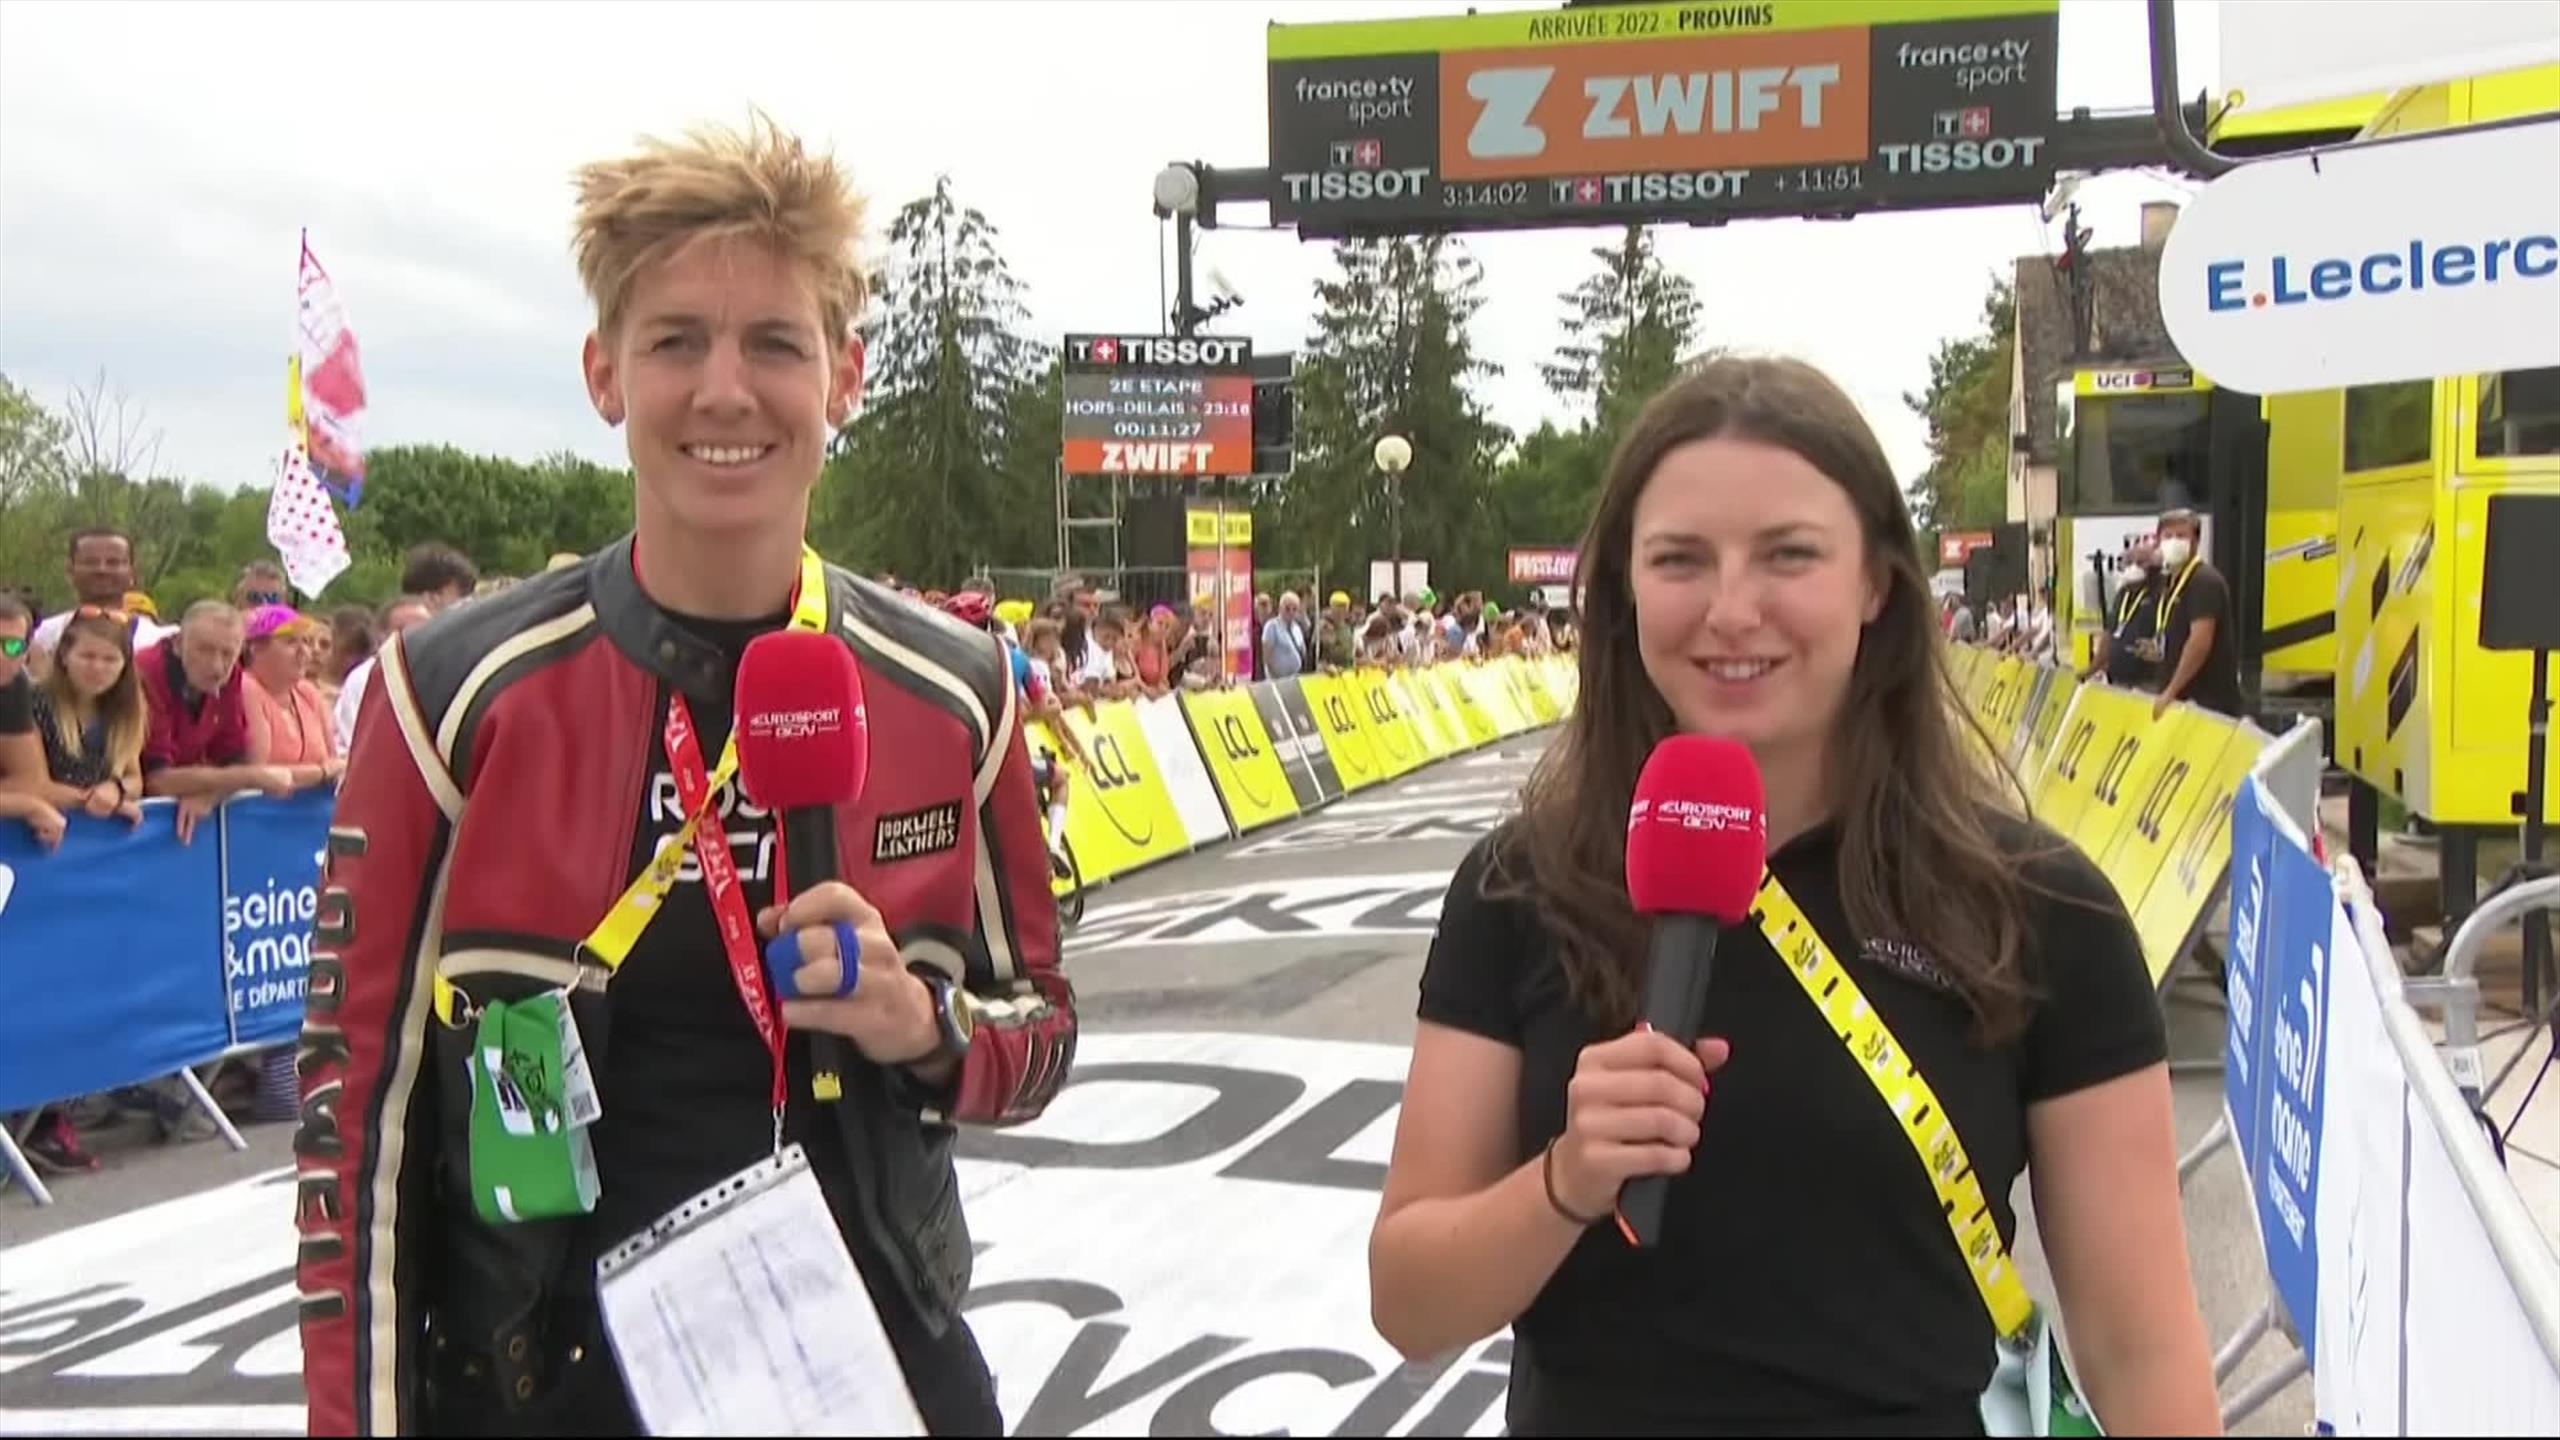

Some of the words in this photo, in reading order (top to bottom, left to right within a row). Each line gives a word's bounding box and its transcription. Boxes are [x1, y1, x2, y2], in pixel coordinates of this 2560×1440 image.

[1528, 12, 1606, 41] ARRIVÉE
[1615, 11, 1660, 35] 2022
[1678, 4, 1773, 31] PROVINS
[1955, 62, 2028, 92] sport
[1348, 99, 1412, 128] sport
[1583, 63, 1841, 139] ZWIFT
[1878, 137, 2045, 173] TISSOT
[1282, 167, 1430, 201] TISSOT
[1443, 182, 1528, 207] 3:14:02
[1604, 169, 1751, 203] TISSOT
[2207, 234, 2560, 312] E.Leclerc
[1120, 339, 1247, 364] TISSOT
[2097, 374, 2131, 388] UCI
[1102, 443, 1214, 472] ZWIFT
[1212, 713, 1260, 761] LCL
[226, 876, 318, 933] seine
